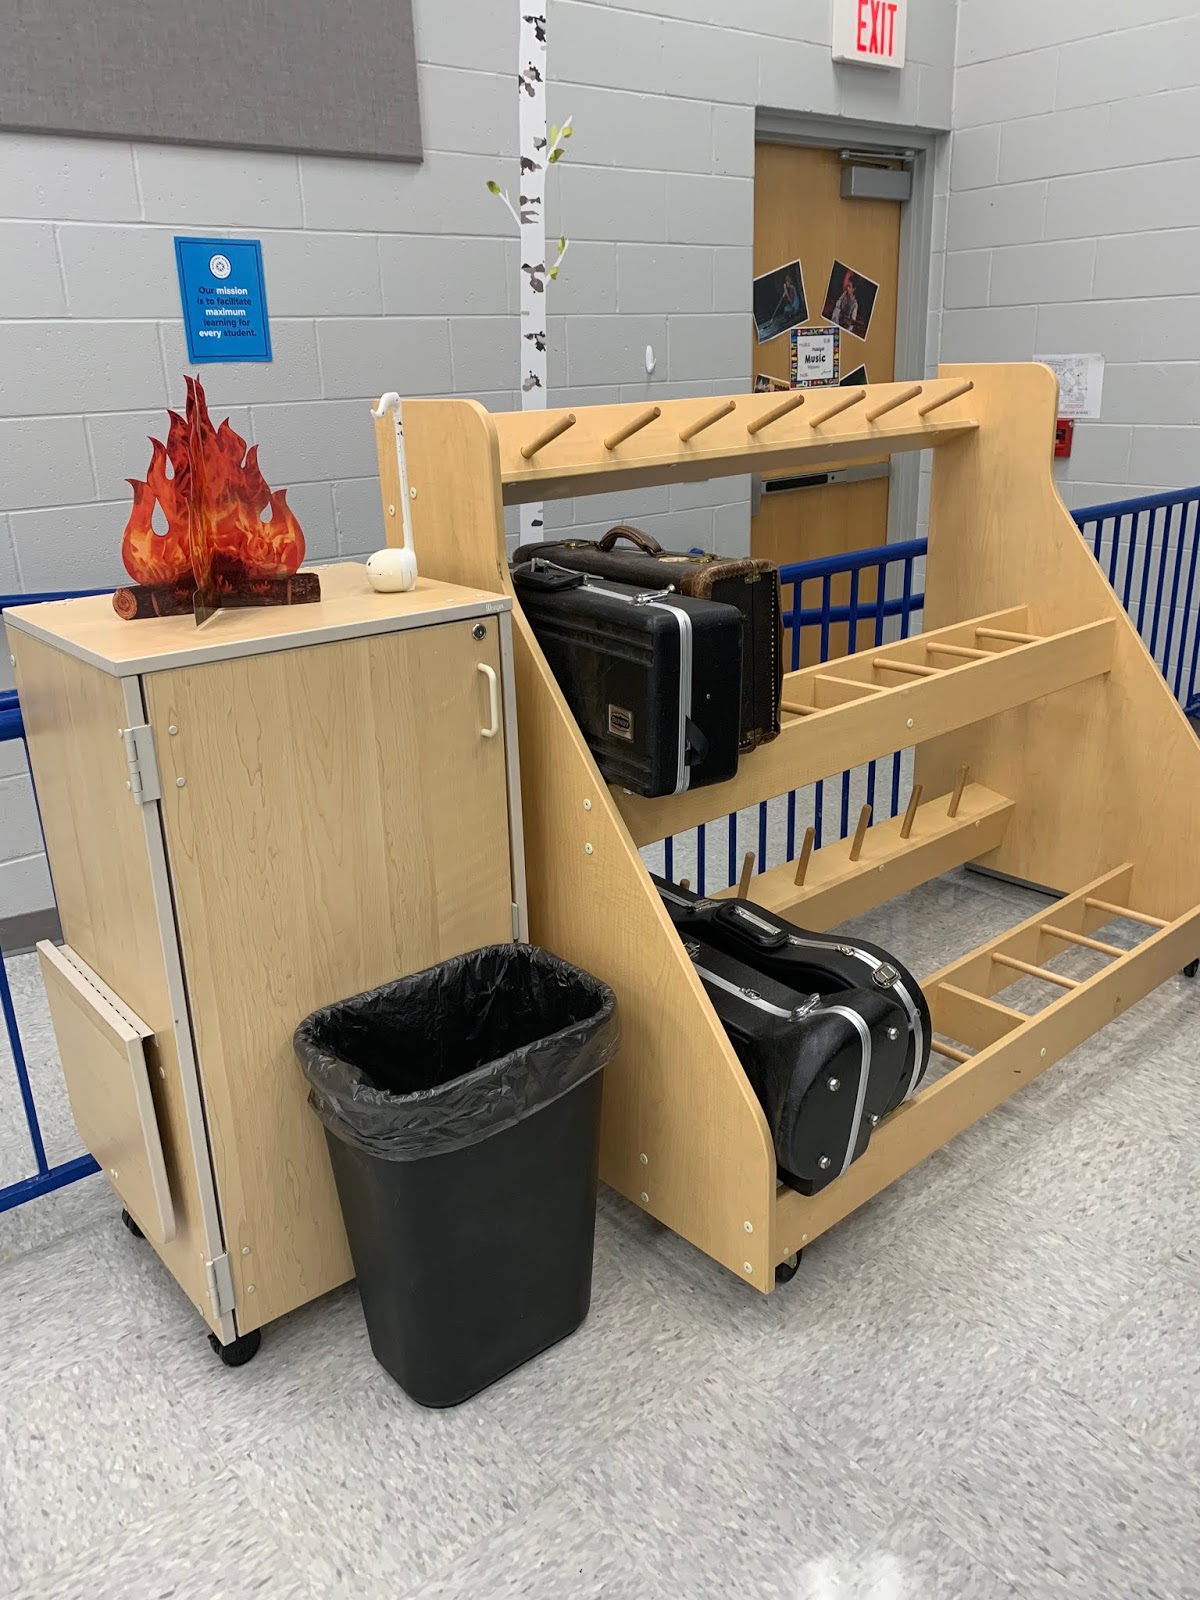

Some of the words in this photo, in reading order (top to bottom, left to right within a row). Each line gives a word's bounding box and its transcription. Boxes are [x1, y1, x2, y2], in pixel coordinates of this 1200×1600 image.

[857, 0, 897, 57] EXIT
[198, 286, 215, 295] Our
[216, 286, 248, 295] mission
[197, 297, 204, 305] is
[206, 297, 215, 305] to
[217, 297, 252, 305] facilitate
[205, 308, 246, 316] maximum
[203, 318, 237, 328] learning
[238, 318, 251, 326] for
[199, 329, 222, 339] every
[224, 329, 257, 337] student.
[805, 354, 826, 364] Music
